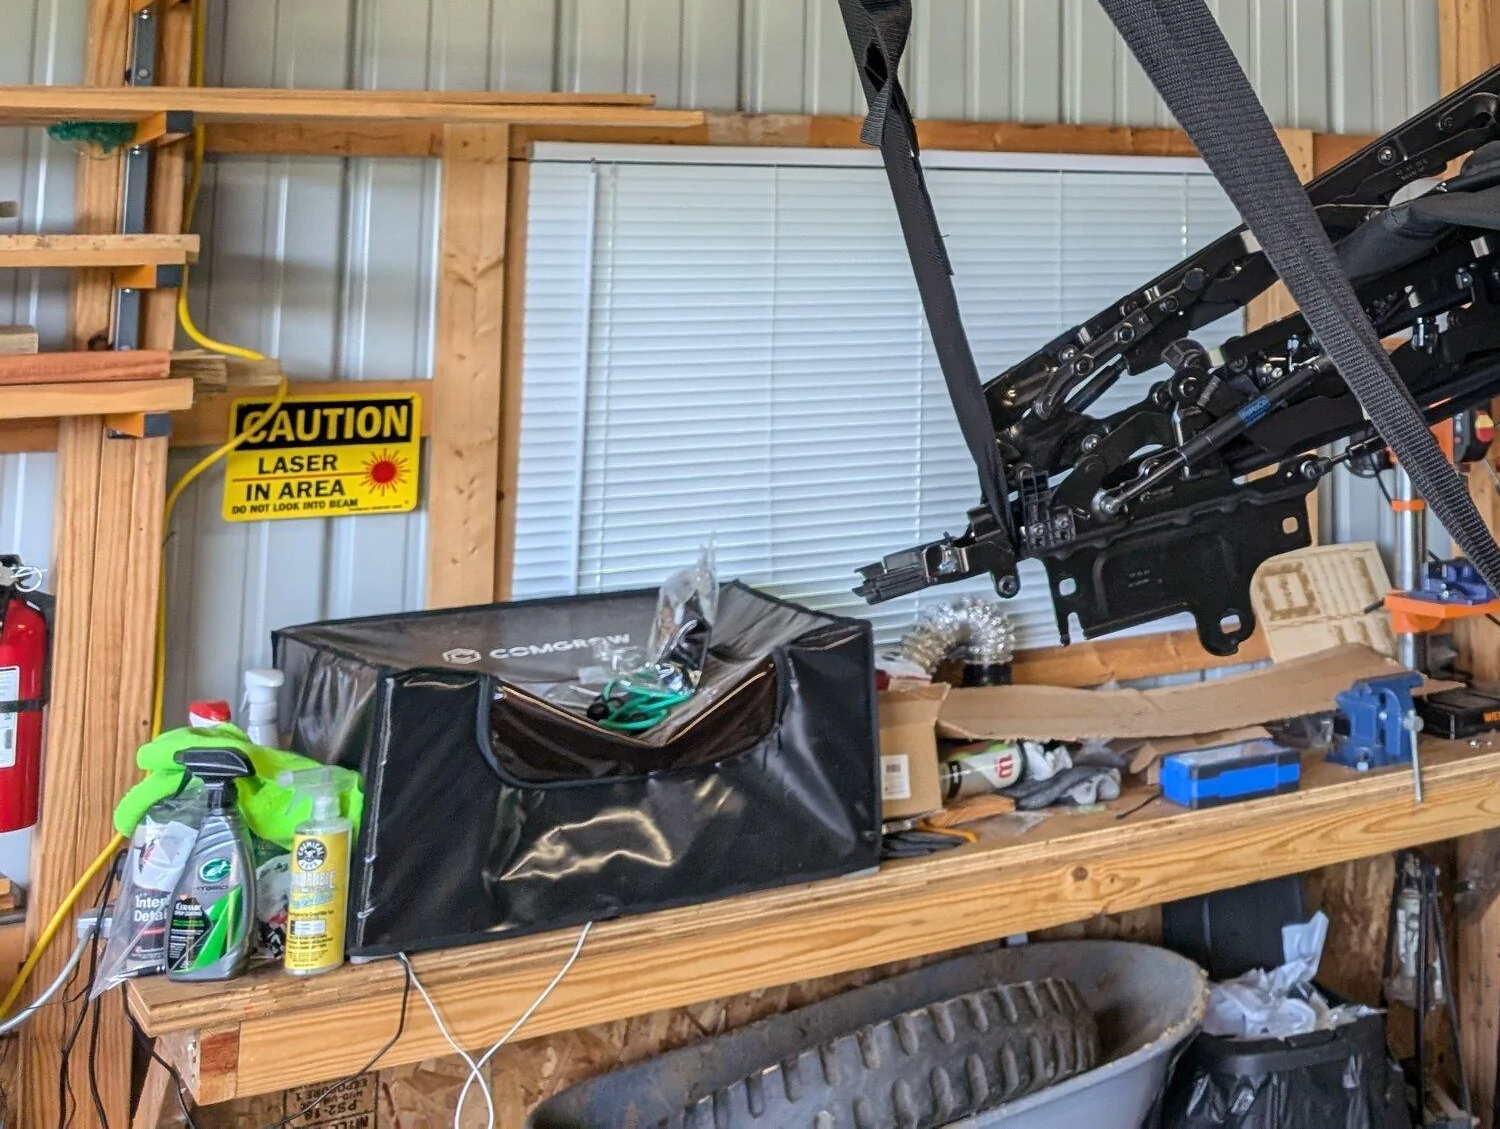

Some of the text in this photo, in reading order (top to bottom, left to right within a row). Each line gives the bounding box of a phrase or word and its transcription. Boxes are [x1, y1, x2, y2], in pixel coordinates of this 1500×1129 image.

[243, 405, 408, 444] CAUTION
[258, 454, 338, 475] LASER
[246, 479, 345, 502] IN AREA
[231, 505, 247, 515] DO
[250, 503, 270, 514] NOT
[273, 501, 299, 512] LOOK
[302, 500, 326, 511] INTO
[329, 498, 359, 509] BEAM
